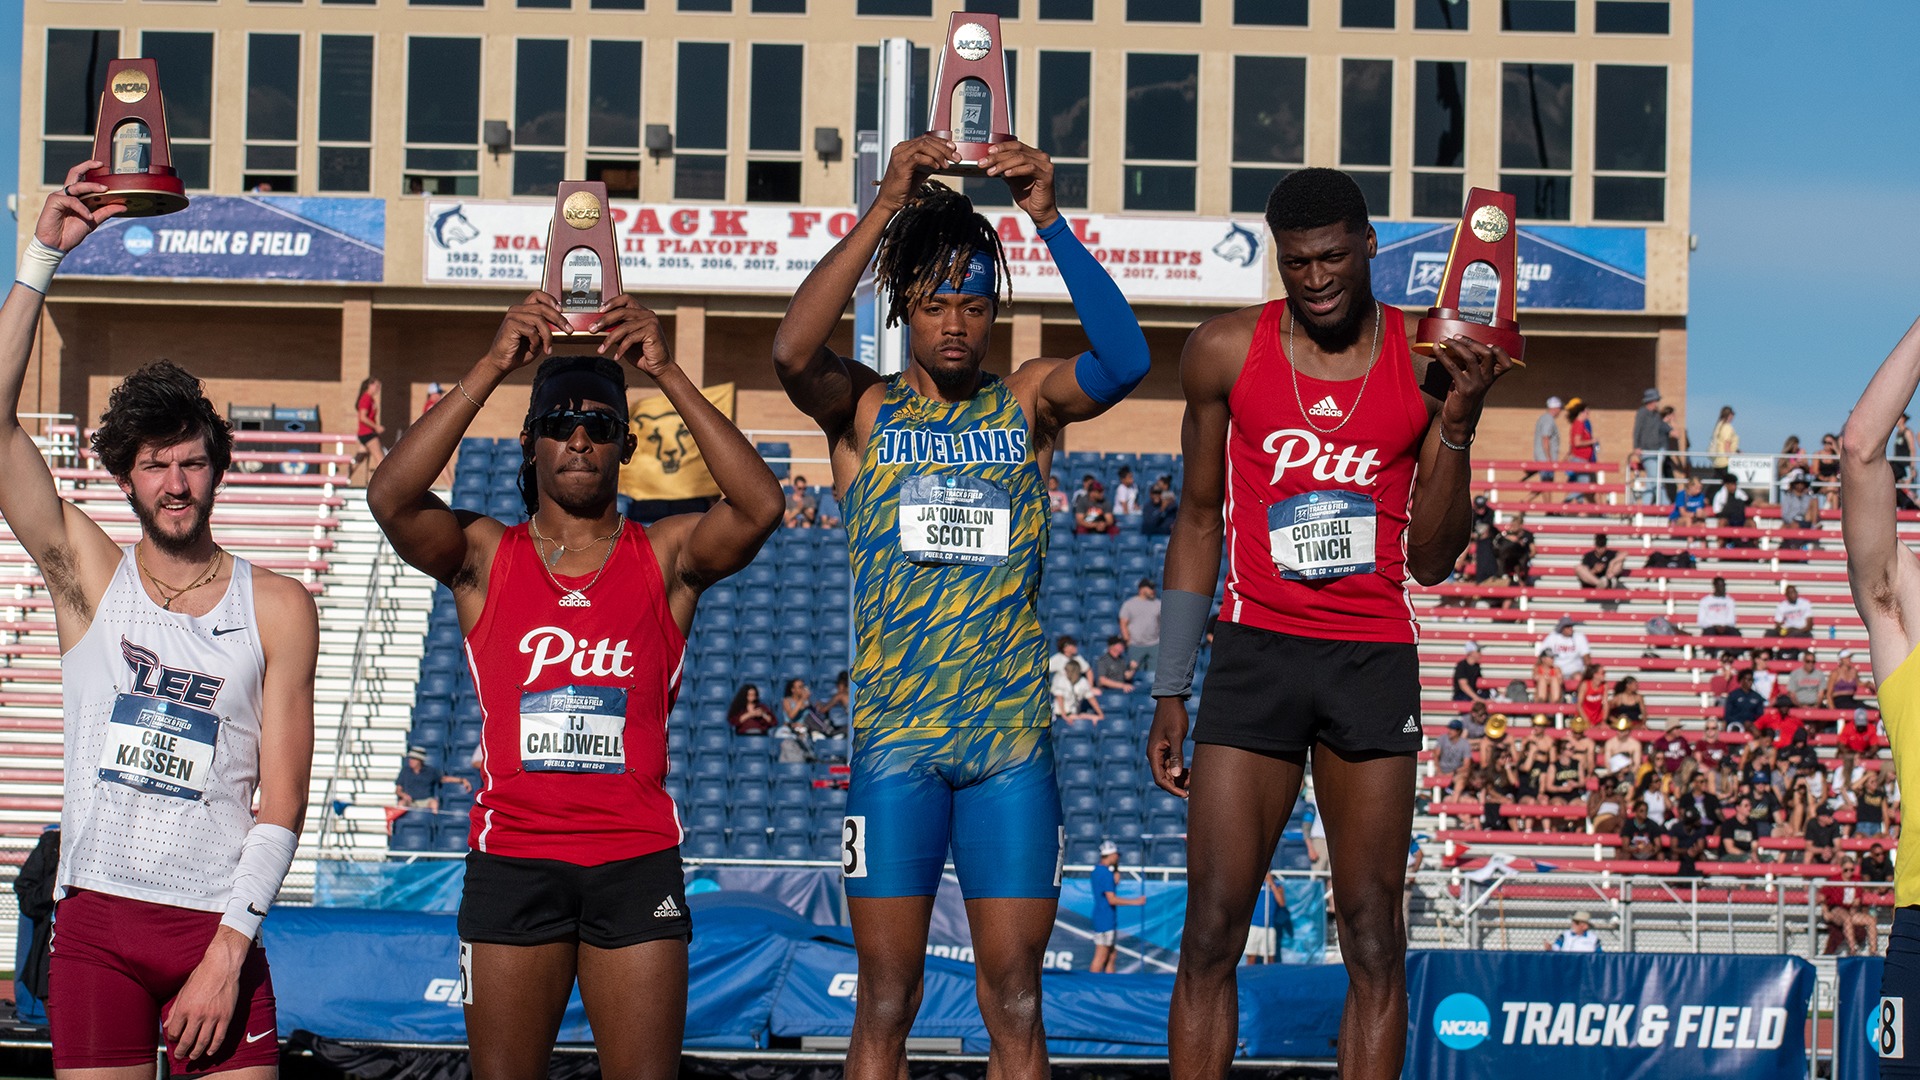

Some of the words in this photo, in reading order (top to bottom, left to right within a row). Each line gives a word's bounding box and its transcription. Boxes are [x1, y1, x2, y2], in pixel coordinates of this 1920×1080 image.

[114, 83, 148, 93] NCAA
[566, 208, 600, 219] NCAA
[159, 229, 231, 254] TRACK
[231, 231, 248, 255] &
[250, 231, 312, 256] FIELD
[494, 235, 546, 250] NCA
[658, 239, 778, 255] PLAYOFFS
[447, 253, 483, 264] 1982,
[490, 254, 523, 265] 2011,
[658, 258, 694, 269] 2015,
[701, 259, 737, 270] 2016,
[744, 259, 780, 271] 2017,
[446, 267, 483, 279] 2019,
[1123, 268, 1159, 280] 2017,
[1165, 268, 1202, 281] 2018,
[1309, 407, 1343, 417] adidas
[877, 428, 1027, 464] JAVELINAS
[1262, 428, 1381, 486] Pitt
[1731, 460, 1771, 468] SECTION
[1745, 470, 1755, 482] V
[926, 524, 984, 548] SCOTT
[1292, 520, 1352, 541] CORDELL
[1294, 537, 1351, 563] TINCH
[1319, 567, 1326, 575] CO
[558, 599, 591, 607] adidas
[519, 626, 634, 686] Pitt
[131, 660, 225, 710] LEE
[568, 715, 584, 731] TJ
[141, 730, 177, 752] CALE
[527, 732, 621, 757] CALDWELL
[115, 743, 194, 781] KASSEN
[544, 760, 566, 768] PUEBLO,
[567, 760, 575, 768] CO
[118, 772, 140, 783] PUEBLO,
[141, 775, 149, 784] CO
[844, 819, 857, 874] 3
[653, 909, 681, 917] adidas
[1439, 1020, 1489, 1037] NCAA
[1502, 1002, 1635, 1046] TRACK
[1637, 1005, 1669, 1047] &
[1674, 1005, 1788, 1049] FIELD
[1882, 1000, 1896, 1055] 8
